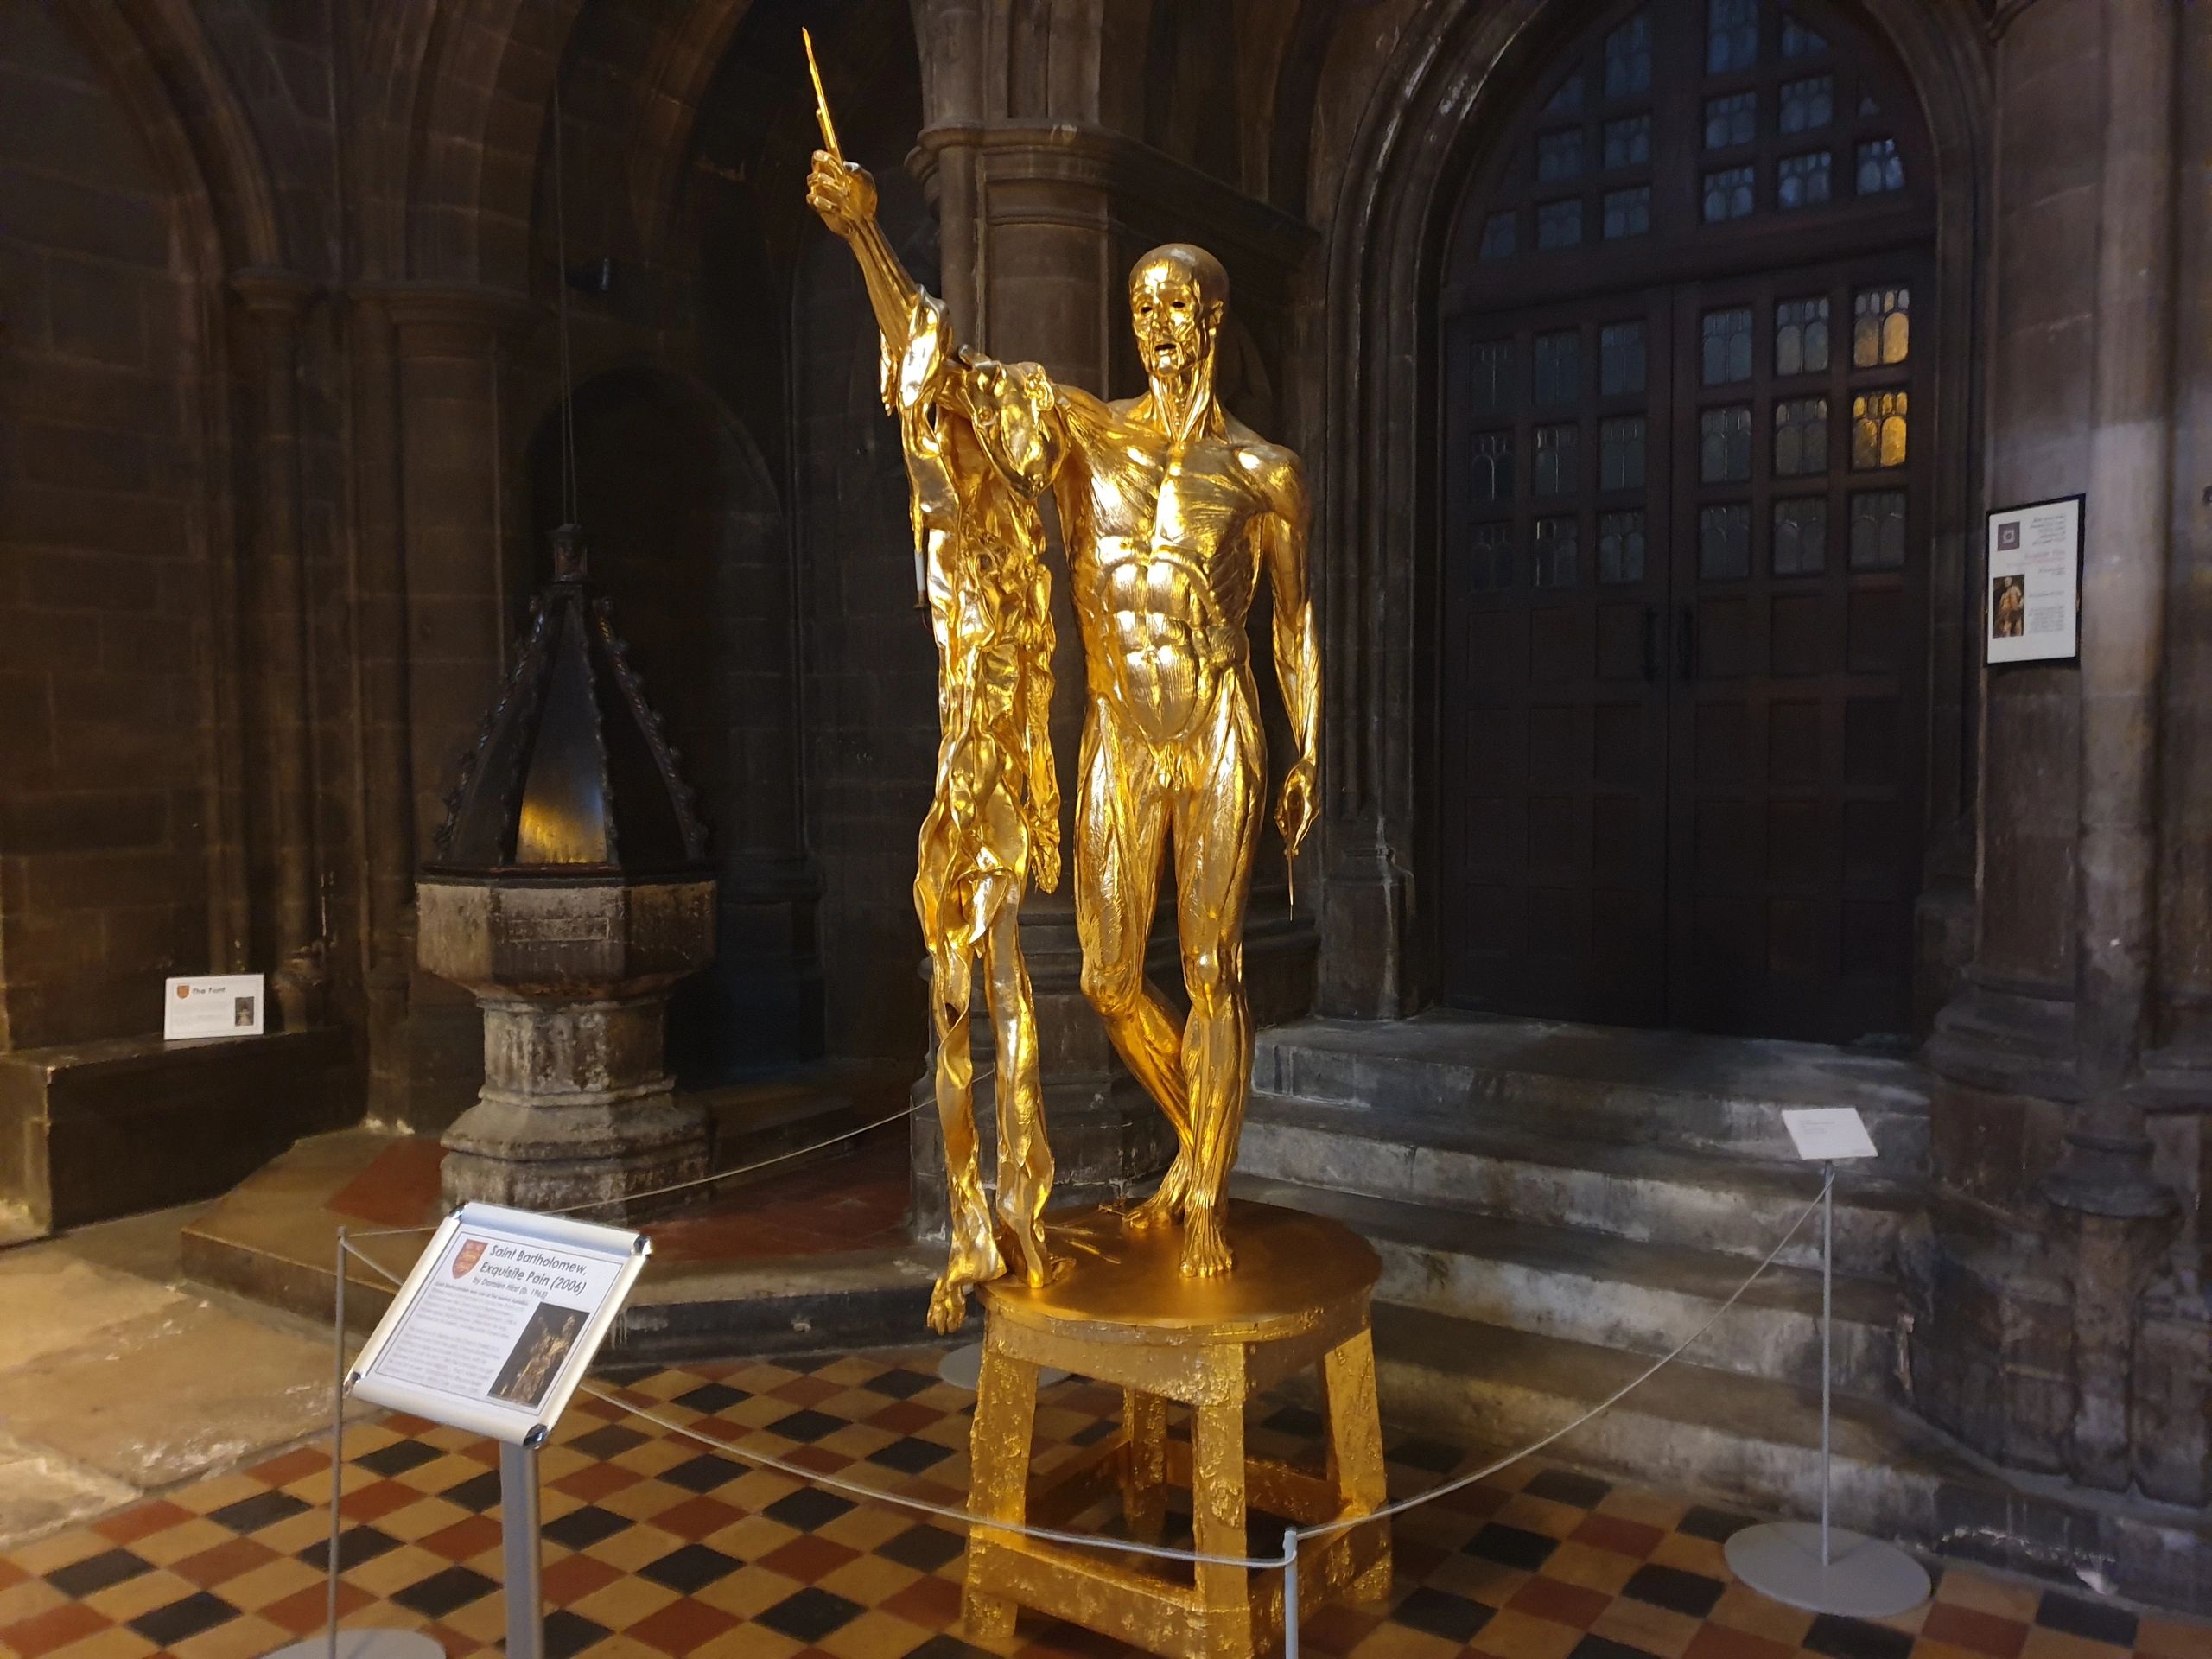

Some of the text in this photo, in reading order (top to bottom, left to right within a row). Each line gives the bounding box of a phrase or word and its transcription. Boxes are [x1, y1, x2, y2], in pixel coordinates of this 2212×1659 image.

[490, 1244, 588, 1276] Saint Bartholomew,
[480, 1262, 587, 1296] Exquisite Pain (2006)
